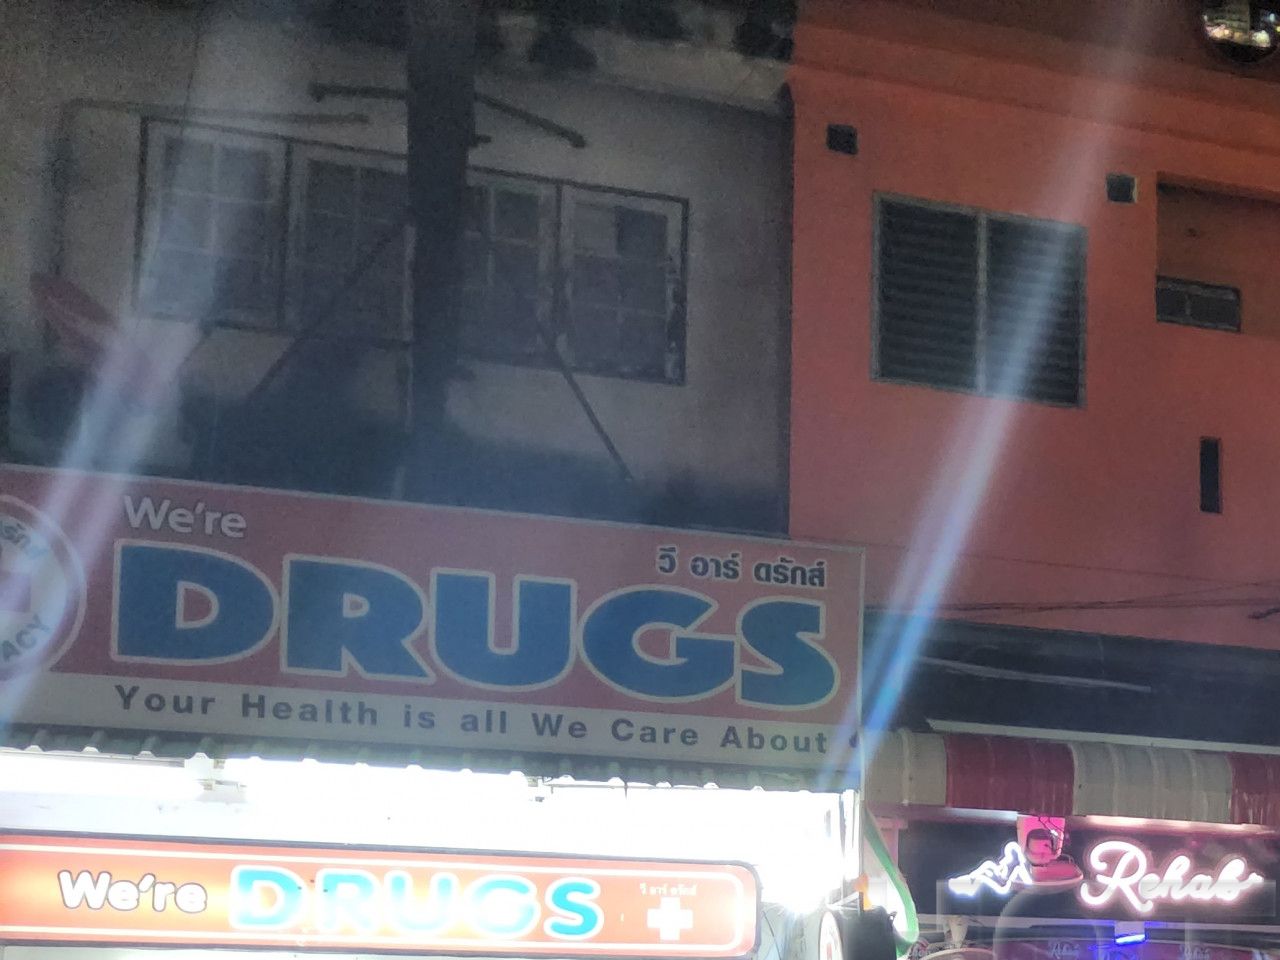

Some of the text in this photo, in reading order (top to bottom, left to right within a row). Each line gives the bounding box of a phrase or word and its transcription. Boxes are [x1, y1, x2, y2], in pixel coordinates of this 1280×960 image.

[124, 496, 247, 538] We're
[659, 547, 677, 574] วี
[691, 553, 740, 580] อาร์
[112, 538, 839, 712] DRUGS
[115, 684, 828, 754] Your Health is all We Care About
[58, 865, 605, 940] We're DRUGS
[1080, 840, 1265, 913] Rehab
